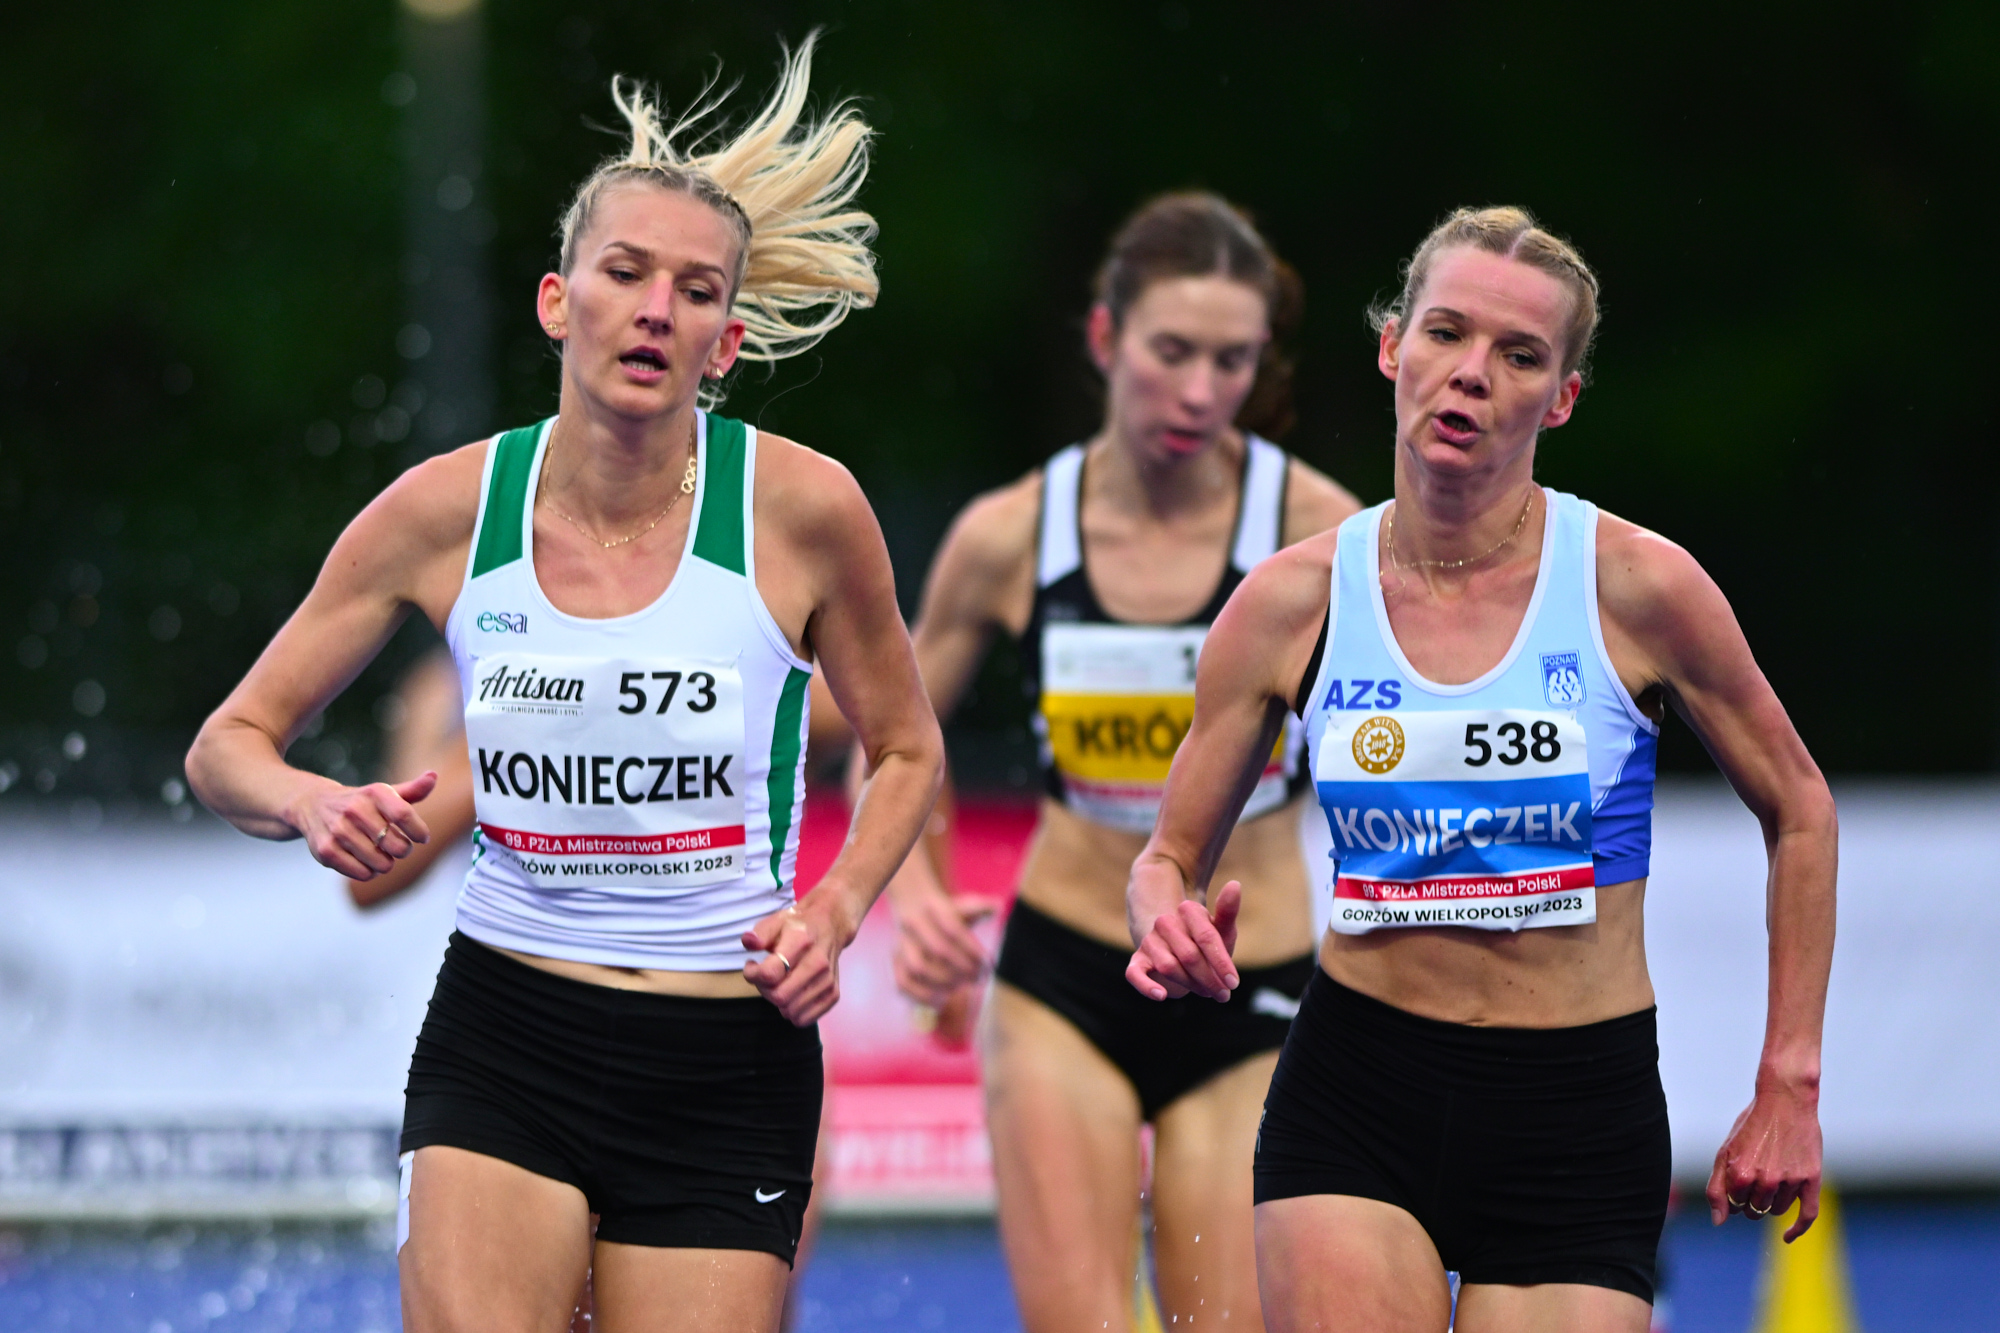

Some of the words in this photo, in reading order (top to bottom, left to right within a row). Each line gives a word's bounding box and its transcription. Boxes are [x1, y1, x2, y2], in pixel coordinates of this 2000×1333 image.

[479, 664, 585, 702] Artisan
[617, 671, 717, 716] 573
[1322, 679, 1402, 710] AZS
[1073, 705, 1194, 759] KRÓ
[1464, 720, 1561, 767] 538
[478, 747, 735, 807] KONIECZEK
[504, 831, 526, 850] 99.
[529, 836, 563, 854] PZLA
[567, 836, 663, 854] Mistrzostwa
[666, 831, 711, 851] Polski
[1332, 801, 1582, 857] KONIECZEK
[561, 861, 690, 877] WIELKOPOLSKI
[693, 854, 733, 873] 2023
[1382, 884, 1419, 900] PZLA
[1422, 880, 1514, 898] Mistrzostwa
[1518, 873, 1561, 892] Polski
[1341, 901, 1410, 924] GORZÓW
[1415, 903, 1540, 923] WIELKOPOLSKI
[1543, 896, 1583, 914] 2023
